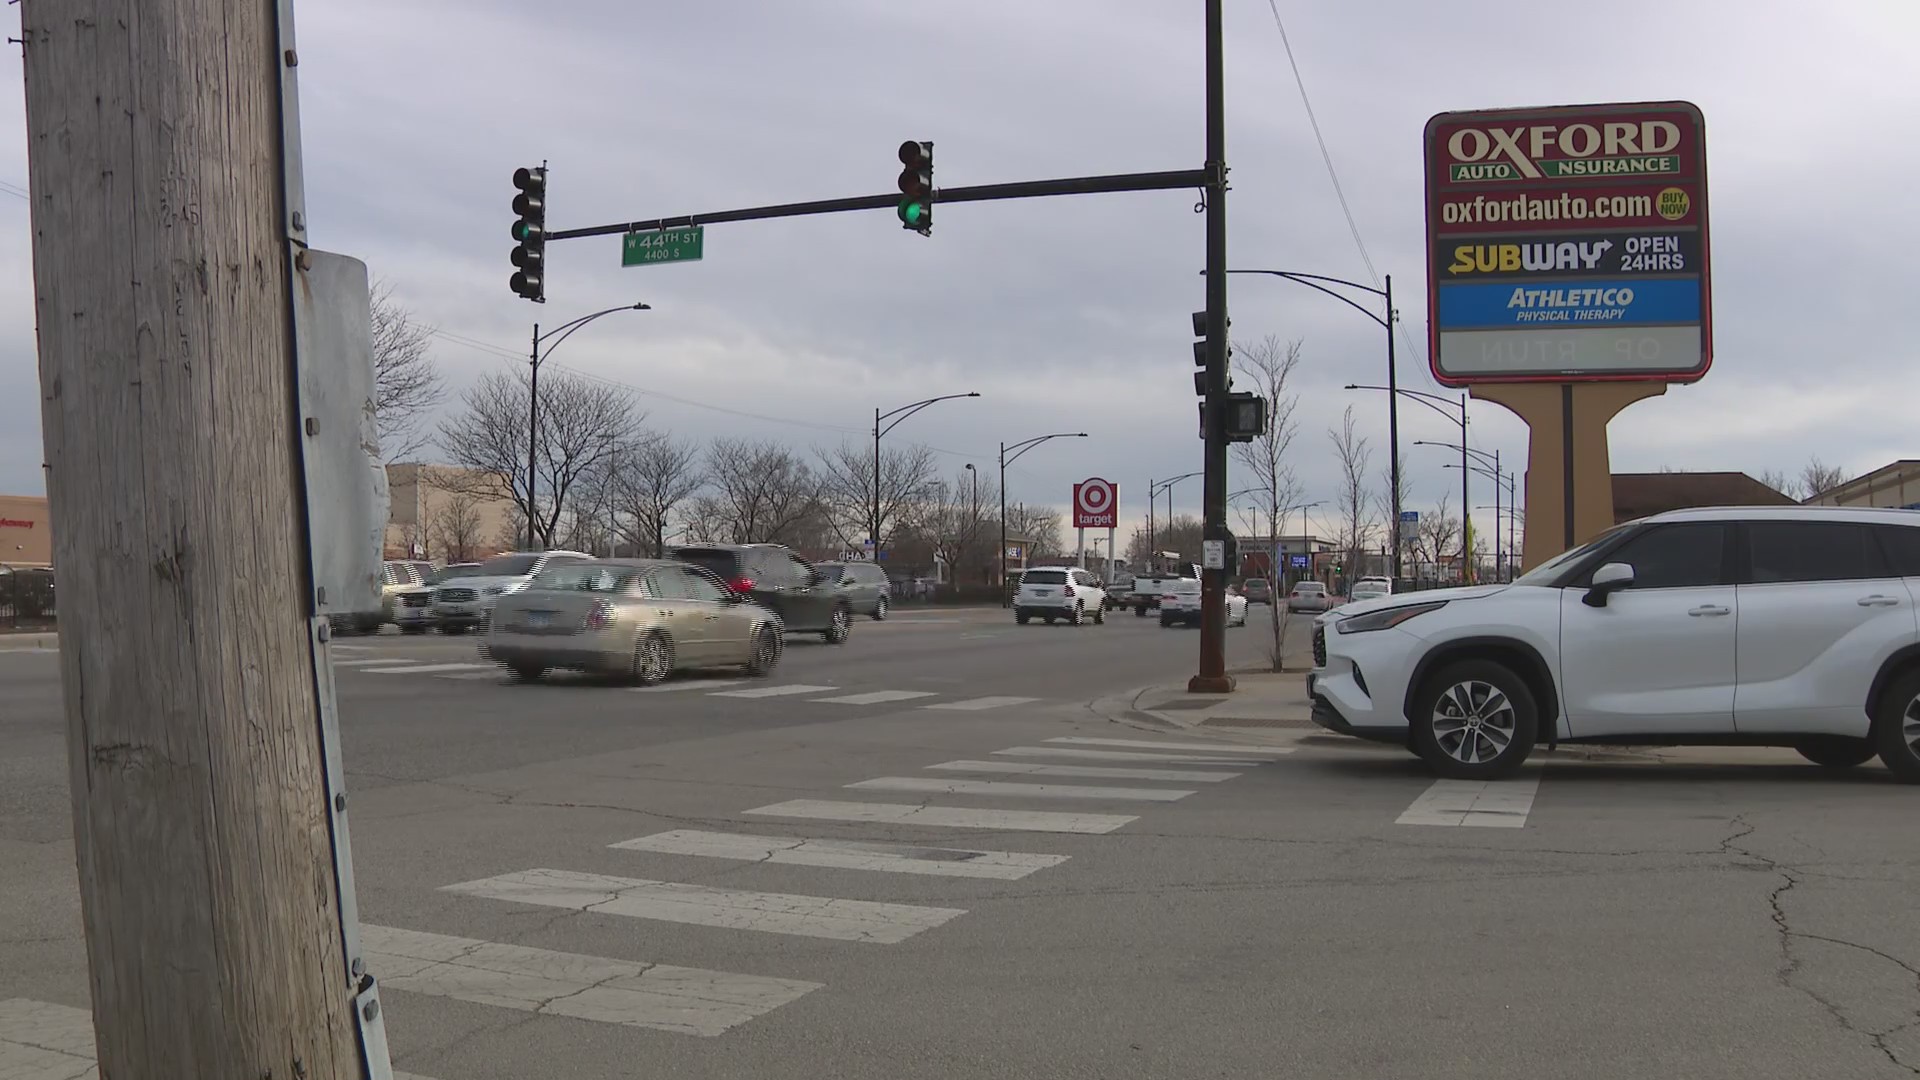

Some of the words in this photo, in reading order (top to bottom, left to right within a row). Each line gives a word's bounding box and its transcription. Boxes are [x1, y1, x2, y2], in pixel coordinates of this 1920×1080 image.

[1448, 121, 1681, 178] OXFORD
[1457, 164, 1510, 179] AUTO
[1662, 192, 1684, 204] BUY
[1442, 192, 1651, 223] oxfordauto.com
[1661, 204, 1686, 215] NOW
[628, 239, 636, 248] W
[639, 232, 679, 248] 44TH
[683, 232, 698, 243] ST
[1625, 236, 1679, 254] OPEN
[644, 249, 669, 260] 4400
[673, 248, 680, 258] S
[1448, 239, 1613, 275] SUBWAY
[1620, 254, 1684, 271] 24HRS
[1507, 287, 1634, 309] ATHLETICO
[1516, 309, 1570, 321] PHYSICAL
[1573, 308, 1625, 320] THERAPY
[1078, 513, 1112, 526] target
